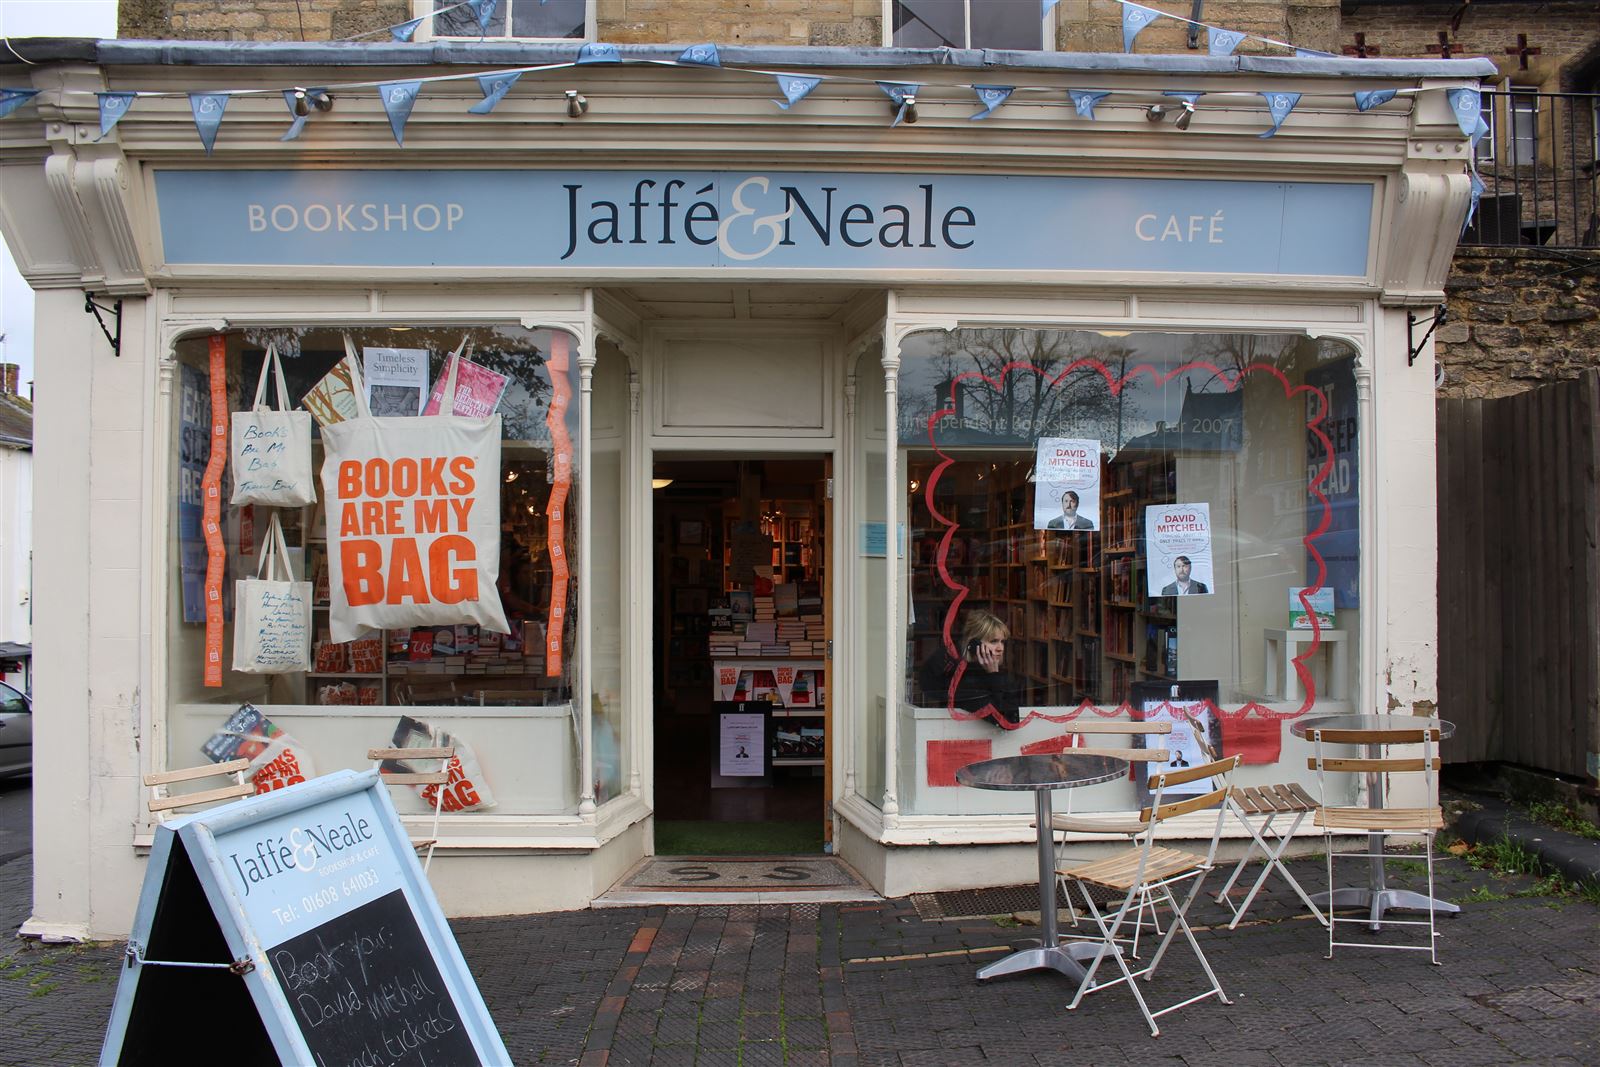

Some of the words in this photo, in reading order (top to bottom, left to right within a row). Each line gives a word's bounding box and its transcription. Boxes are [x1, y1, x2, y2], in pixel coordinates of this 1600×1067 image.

[248, 203, 465, 233] BOOKSHOP
[560, 178, 719, 260] Jaffé
[779, 184, 976, 249] Neale
[1135, 209, 1224, 243] CAFÉ
[373, 362, 418, 376] Simplicity
[376, 352, 416, 363] Timeless
[1152, 418, 1187, 437] year
[1191, 418, 1234, 433] 2007
[1049, 458, 1095, 468] MITCHELL
[1056, 449, 1086, 458] DAVID
[338, 456, 476, 499] BOOKS
[340, 500, 405, 537] ARE
[414, 498, 475, 534] MY
[1157, 523, 1205, 533] MITCHELL
[1164, 514, 1196, 523] DAVID
[340, 534, 479, 607] BAG
[230, 836, 297, 897] Jaffé
[304, 813, 373, 859] Neale
[302, 885, 339, 914] 01608
[342, 868, 380, 897] 641033
[297, 977, 365, 1028] David
[381, 1003, 455, 1058] tickets
